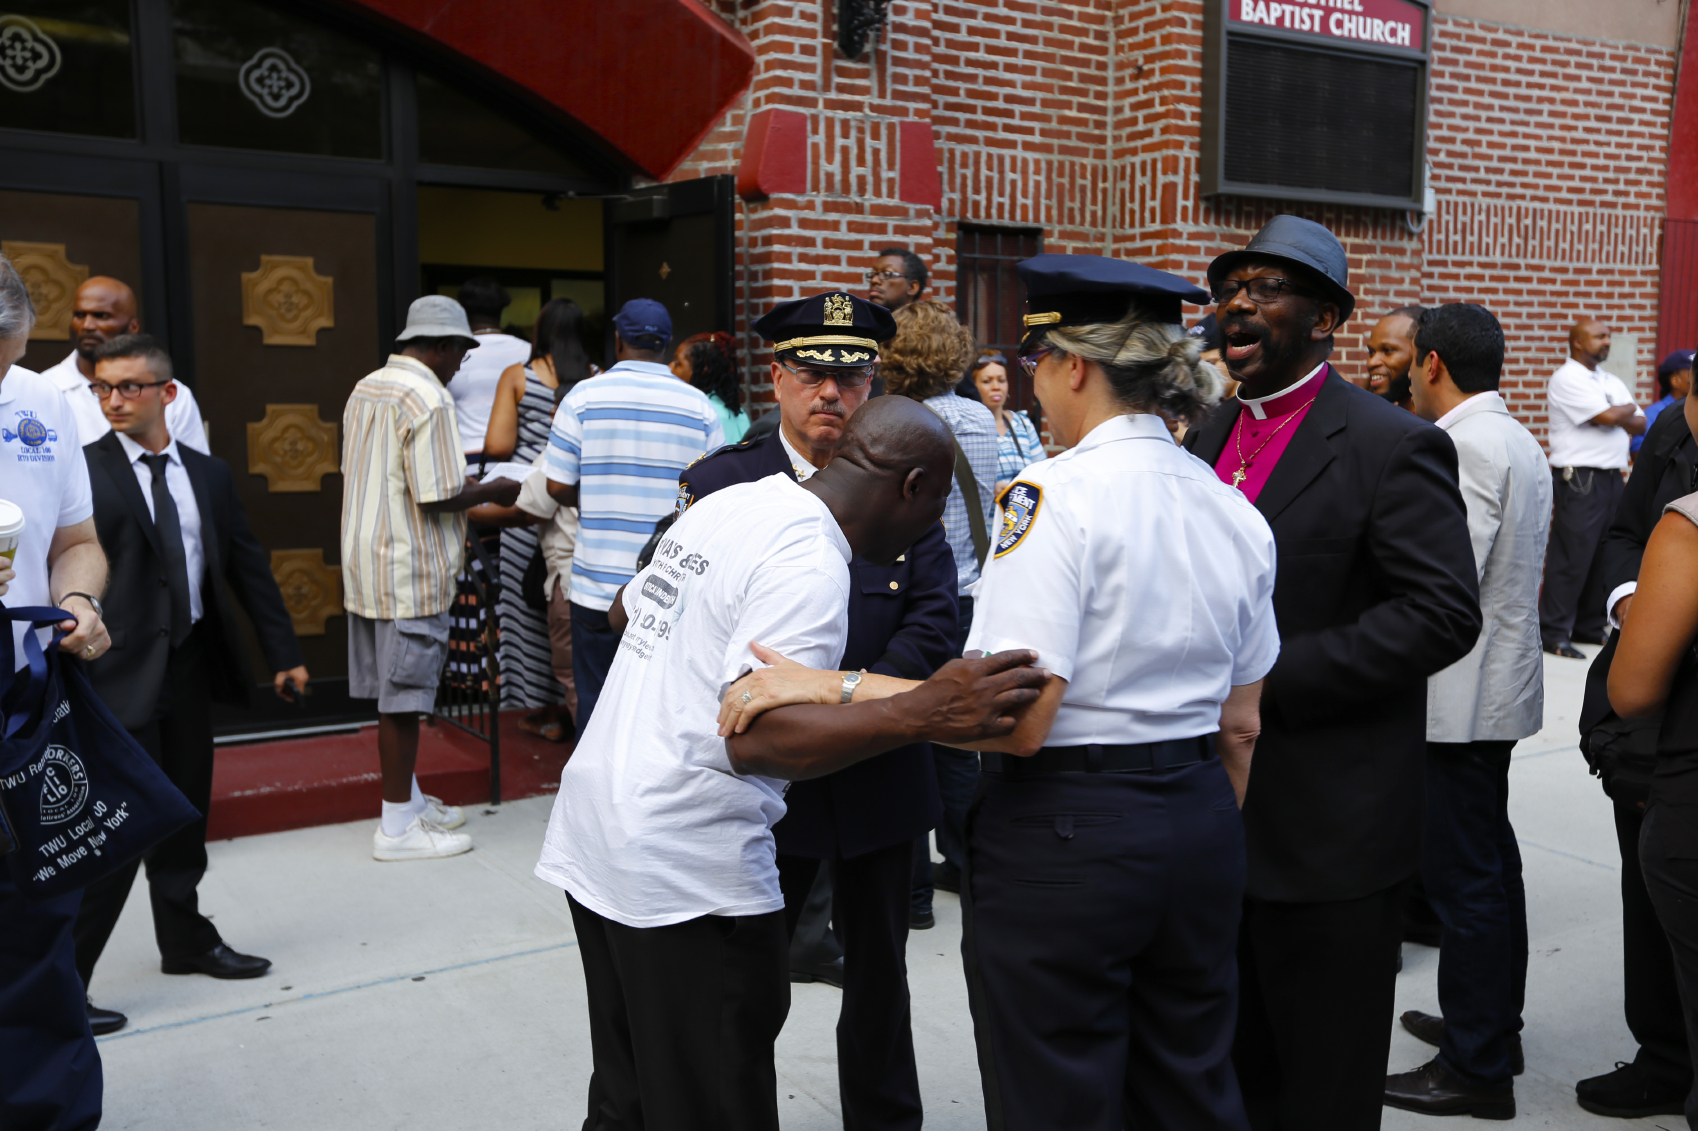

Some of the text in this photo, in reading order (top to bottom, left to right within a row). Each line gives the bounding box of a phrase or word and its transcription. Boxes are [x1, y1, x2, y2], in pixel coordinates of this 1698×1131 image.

[1240, 0, 1411, 47] BAPTIST CHURCH
[21, 446, 41, 454] LOCAL
[1000, 515, 1033, 549] NEW YORK
[48, 749, 84, 780] ORKERS
[39, 835, 67, 857] TWU
[68, 815, 95, 840] Local
[57, 846, 88, 869] Move
[88, 830, 107, 849] New
